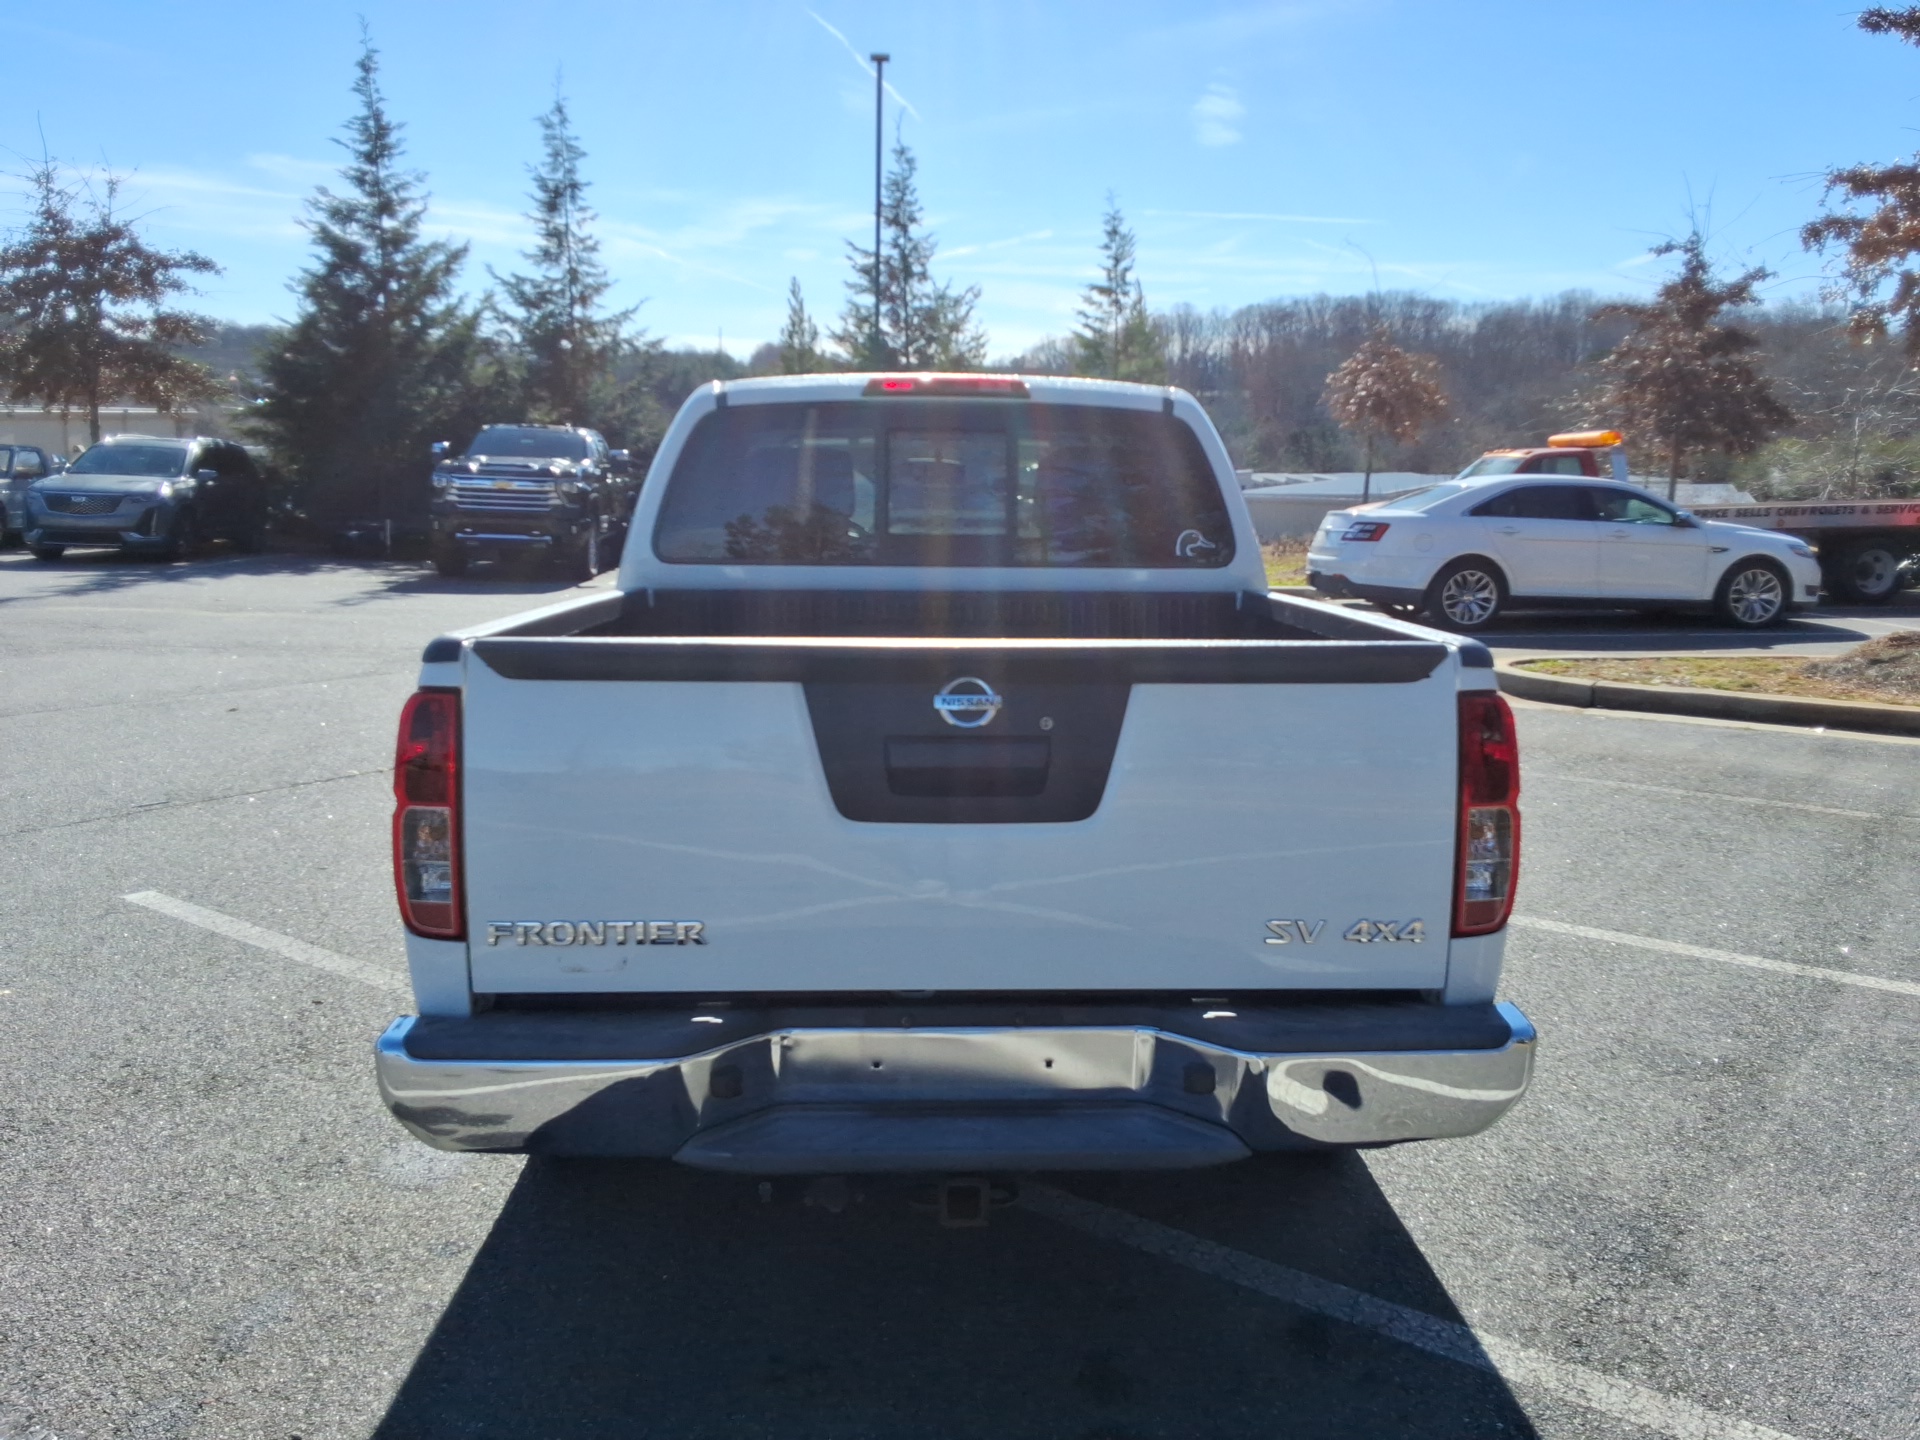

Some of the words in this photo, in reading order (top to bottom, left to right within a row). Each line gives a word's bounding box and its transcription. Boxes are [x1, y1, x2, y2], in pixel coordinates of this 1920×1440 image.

[1734, 507, 1771, 518] SELLS
[1777, 505, 1855, 517] CHEVROLETS
[941, 697, 995, 706] NISSAN
[487, 921, 707, 946] FRONTIER
[1264, 919, 1326, 944] SV
